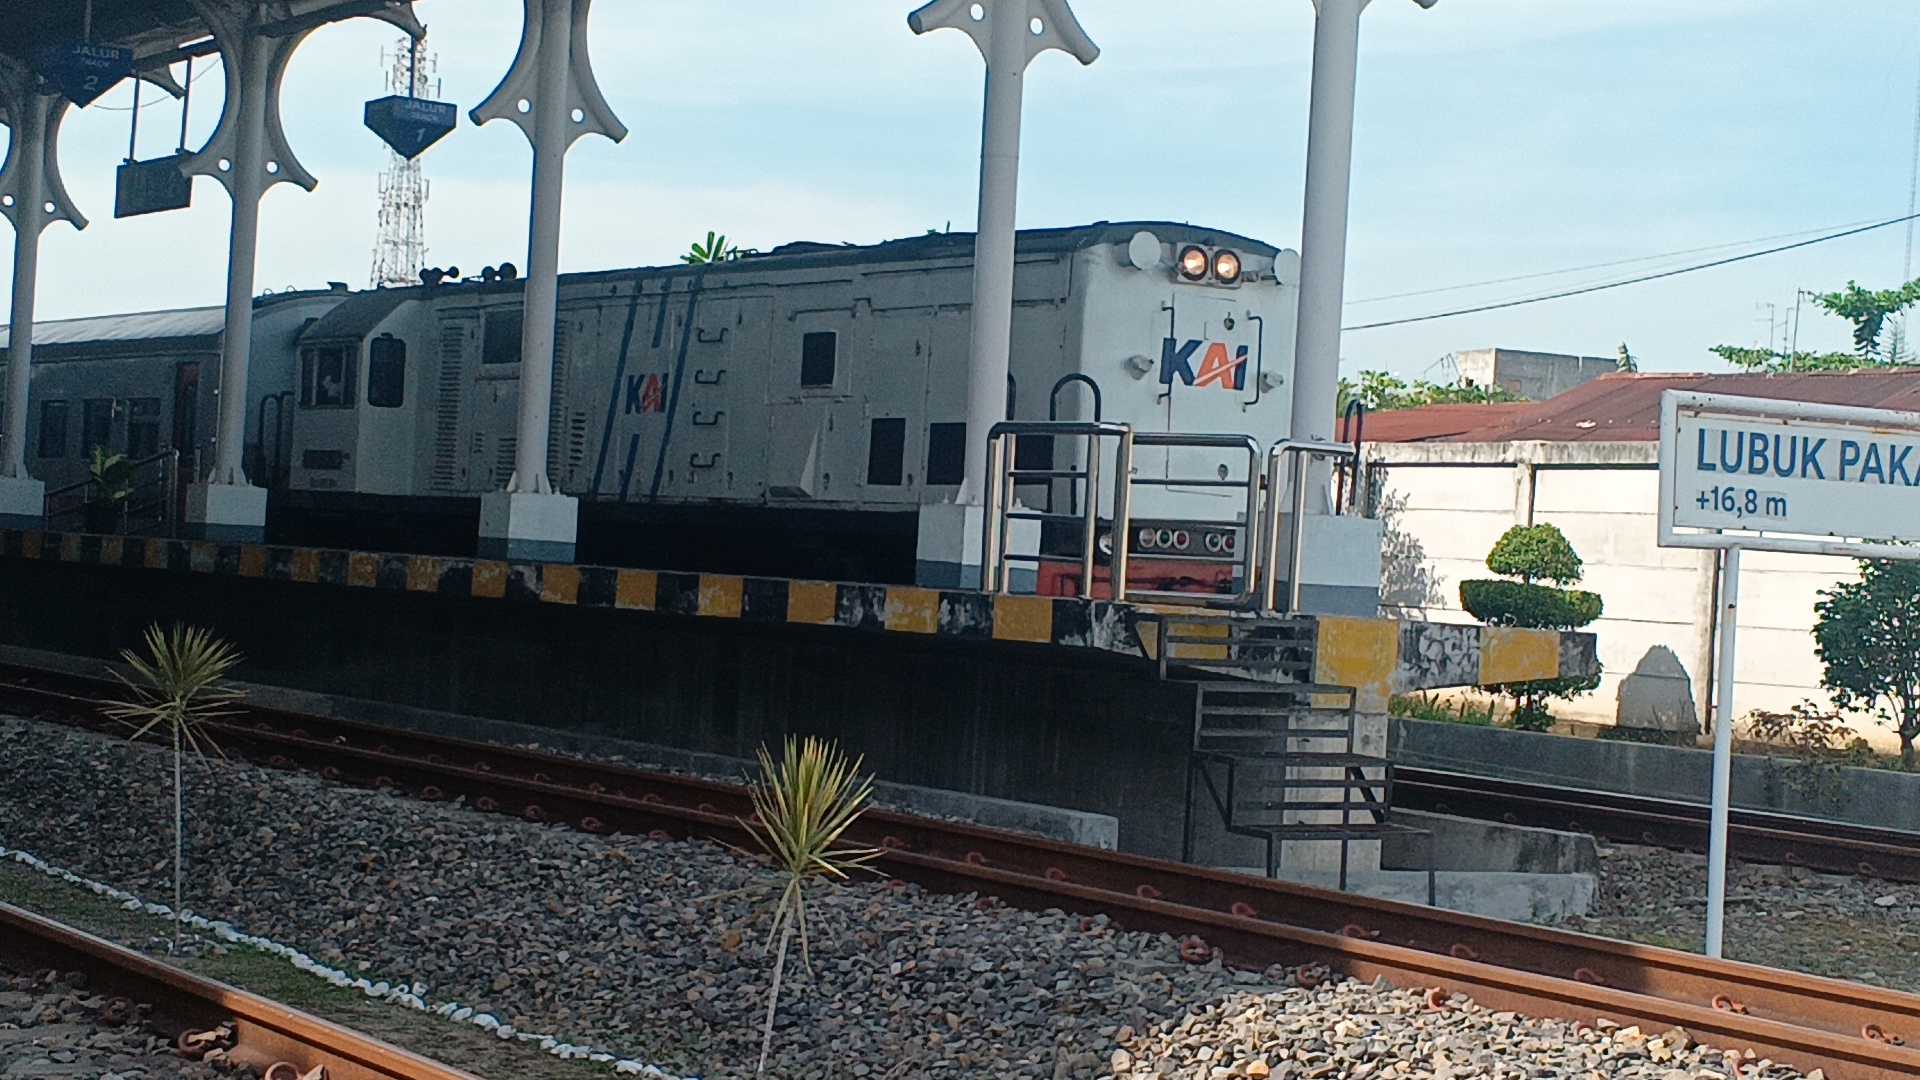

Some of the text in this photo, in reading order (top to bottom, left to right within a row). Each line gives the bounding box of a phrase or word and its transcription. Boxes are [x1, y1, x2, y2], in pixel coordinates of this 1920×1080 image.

[72, 46, 119, 59] JALUR
[83, 75, 98, 91] 2
[405, 100, 446, 114] JALUR
[417, 128, 425, 142] 1
[1159, 337, 1248, 391] KAI
[625, 372, 669, 415] KAI
[1697, 428, 1827, 480] LUBUK
[1696, 486, 1787, 518] +16,8 m
